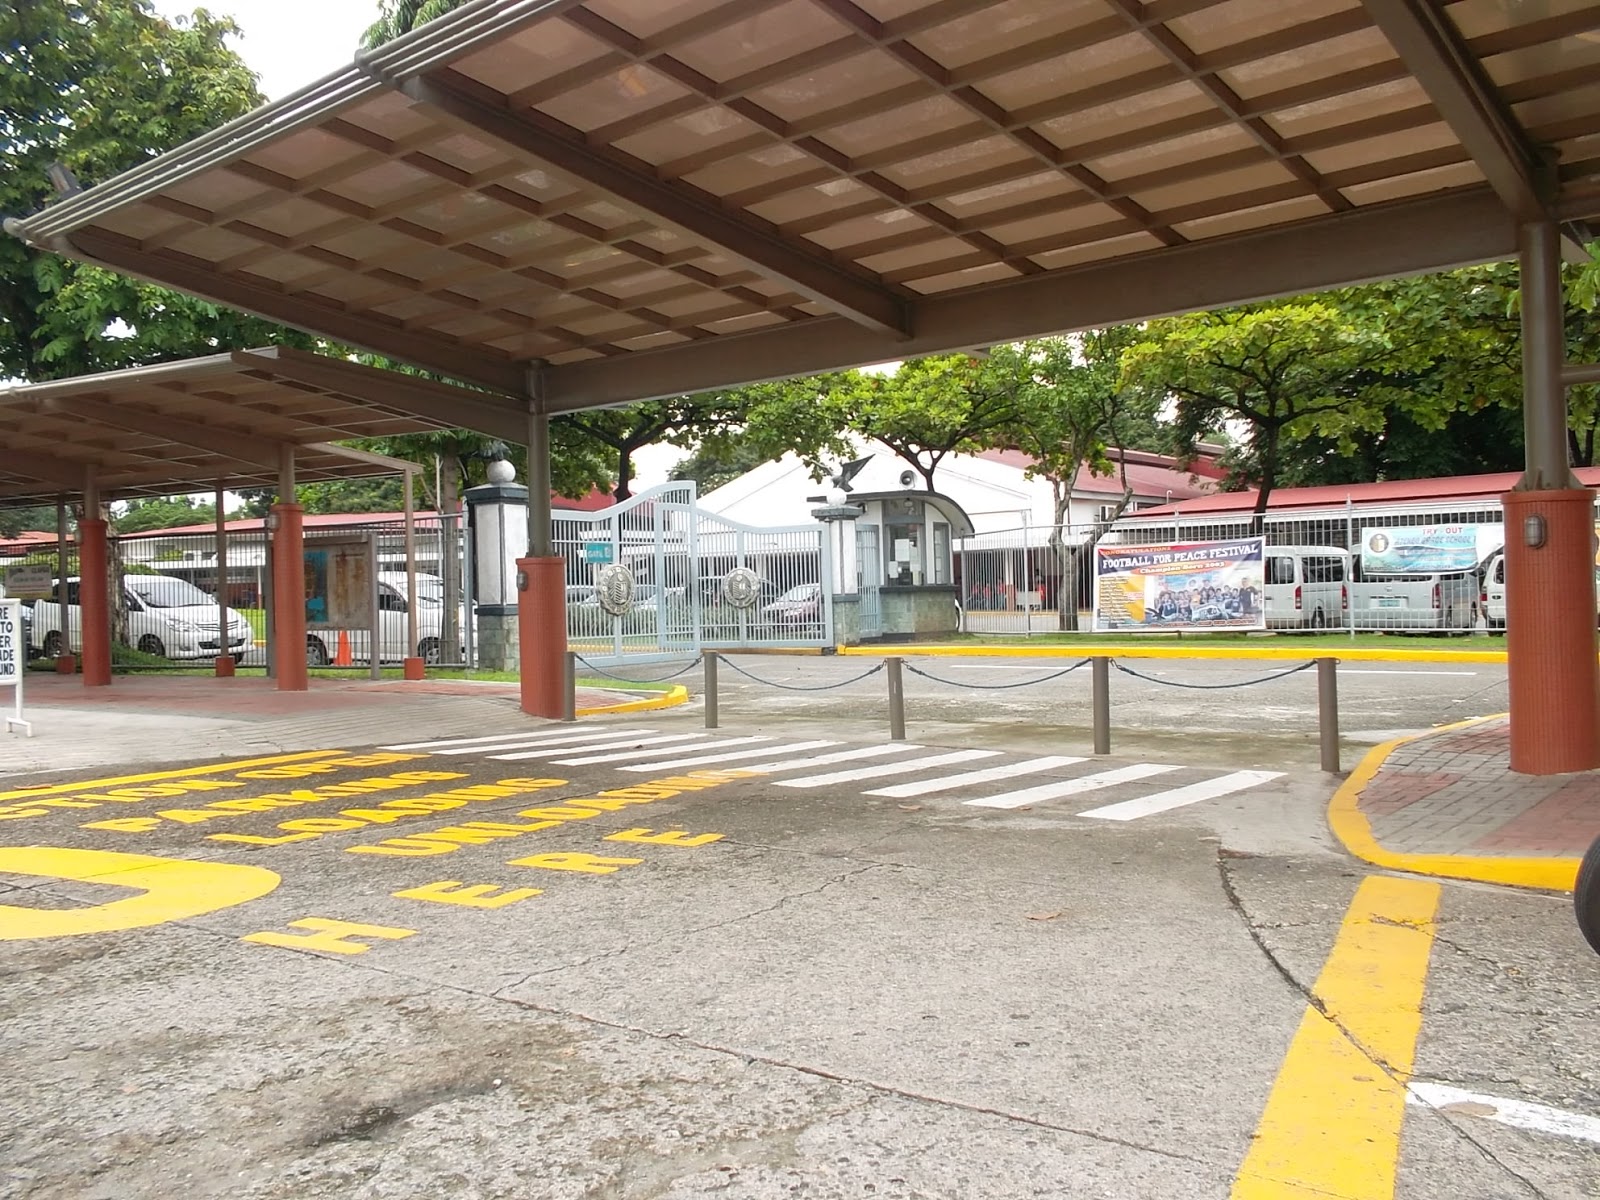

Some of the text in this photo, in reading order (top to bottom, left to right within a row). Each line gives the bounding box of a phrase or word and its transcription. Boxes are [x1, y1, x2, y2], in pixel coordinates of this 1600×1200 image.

[1102, 544, 1259, 569] FOOTBALL FOR PEACE FESTIVAL
[235, 752, 433, 779] OPEN
[77, 770, 471, 833] PARKING
[203, 777, 570, 847] LOADING
[343, 770, 770, 856] UNLOADING
